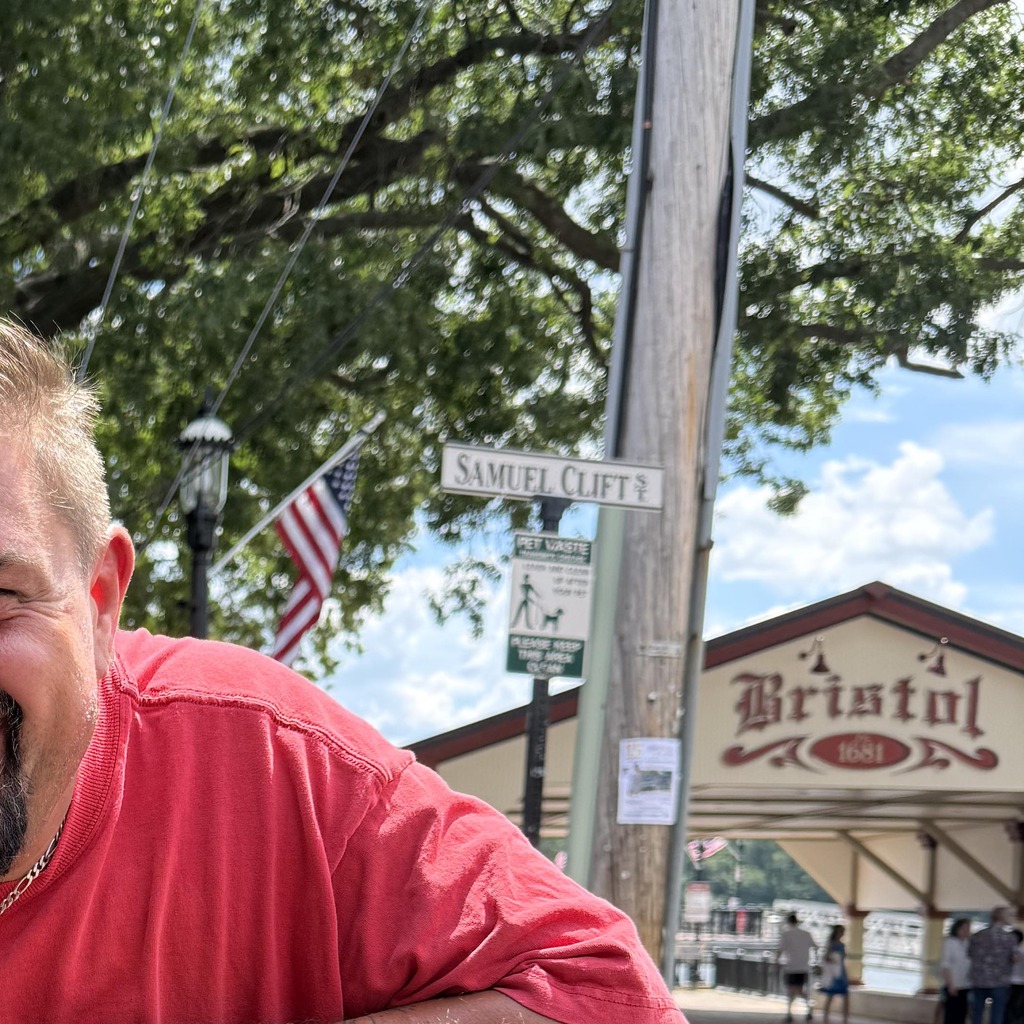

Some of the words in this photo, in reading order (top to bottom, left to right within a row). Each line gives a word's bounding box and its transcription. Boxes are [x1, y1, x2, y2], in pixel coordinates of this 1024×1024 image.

[454, 452, 554, 495] SAMUEL
[561, 464, 630, 500] CLIFT
[517, 537, 543, 550] PET
[545, 540, 590, 555] WASTE
[510, 636, 552, 650] PLEASE
[730, 673, 984, 738] Bristol
[838, 741, 885, 764] 1681
